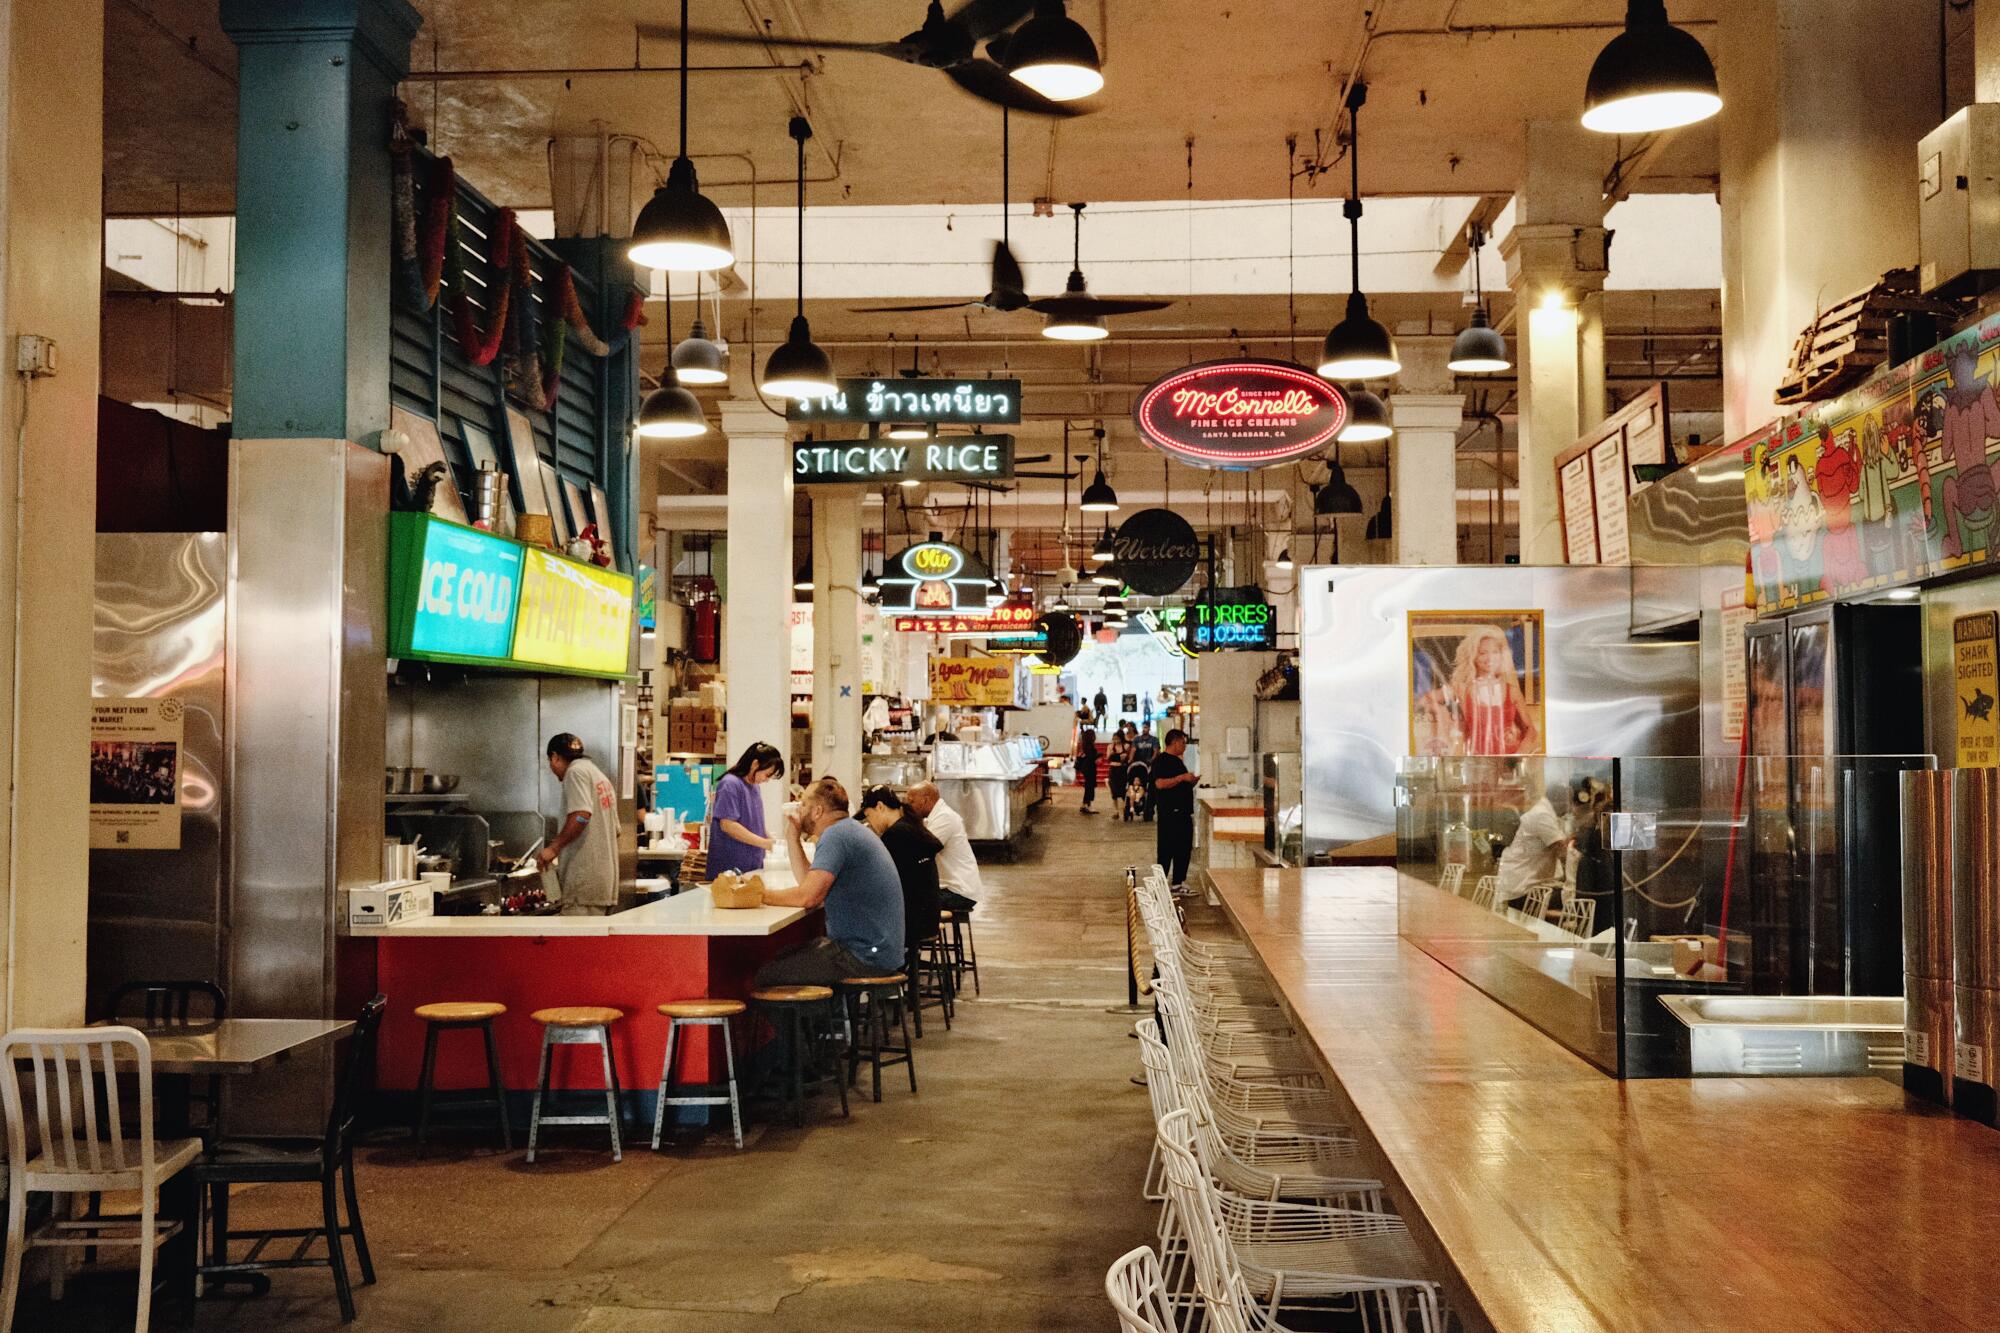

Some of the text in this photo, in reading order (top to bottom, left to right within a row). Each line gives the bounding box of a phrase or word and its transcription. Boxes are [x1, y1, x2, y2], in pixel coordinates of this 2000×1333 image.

[1173, 387, 1319, 416] McConnell's
[1191, 418, 1297, 427] FINE ICE CREAMS
[796, 445, 999, 474] STICKY RICE
[916, 548, 952, 568] Olio
[417, 559, 512, 624] ICE COLD
[1195, 604, 1268, 624] TORRES
[898, 621, 968, 631] PIZZA
[1957, 616, 1991, 641] WARNING
[1961, 645, 1989, 661] SHARK
[1958, 662, 1993, 679] SIGHTED
